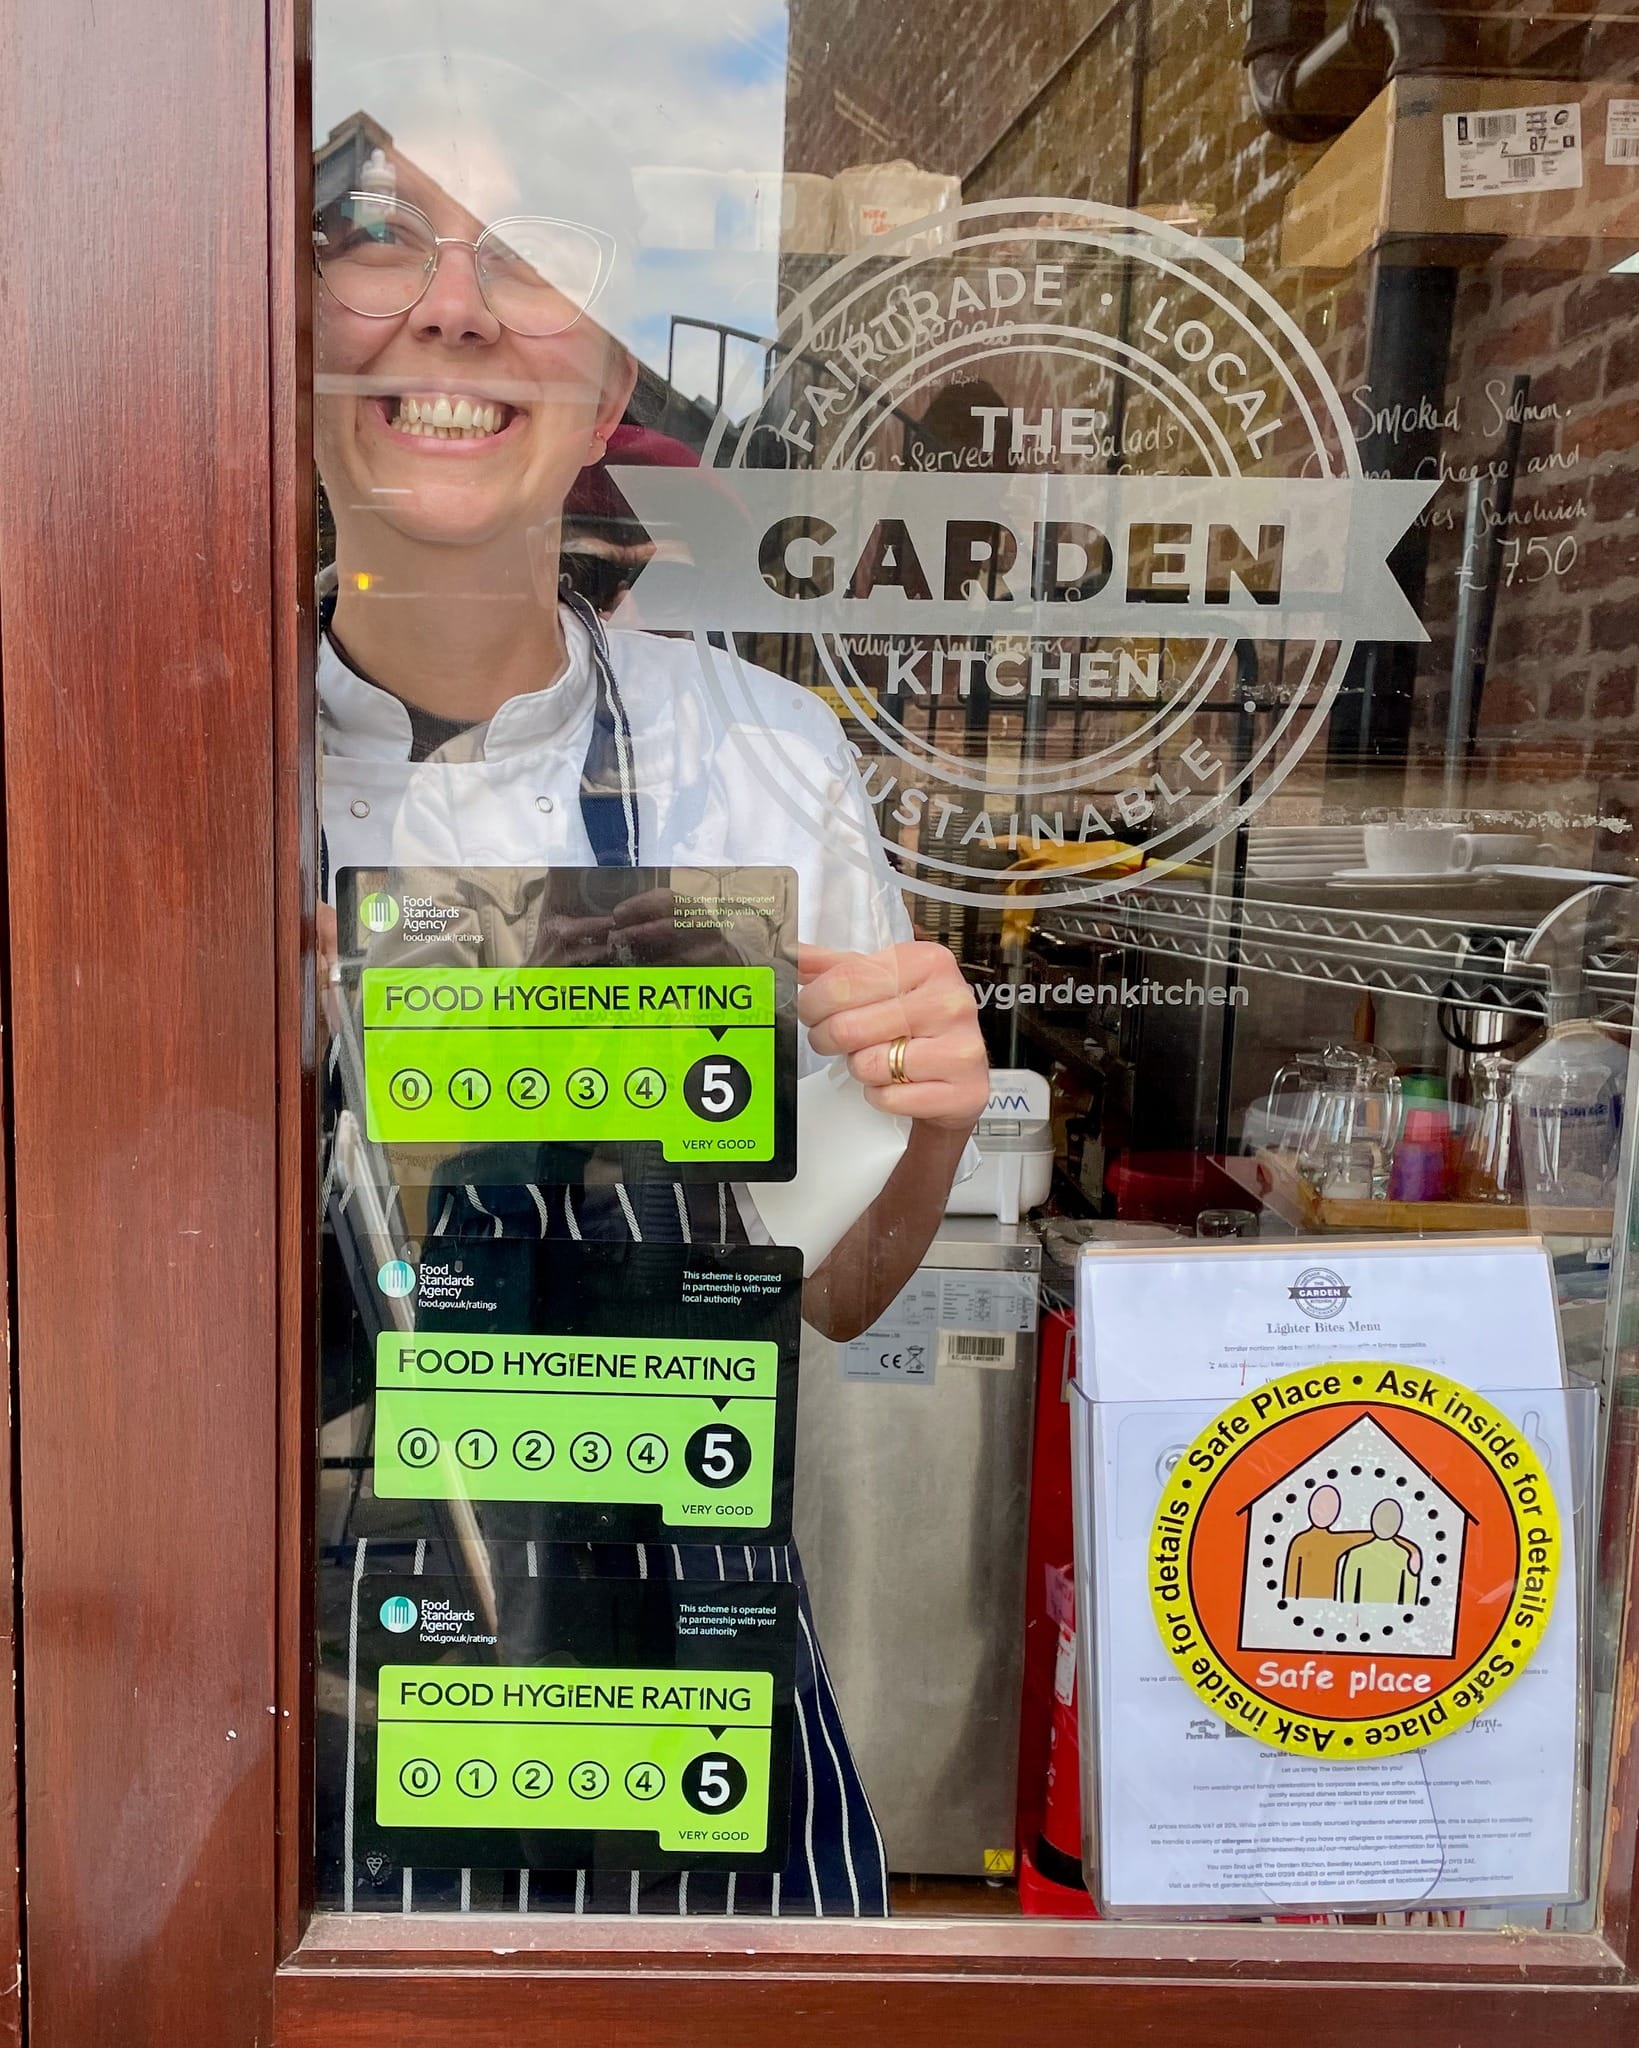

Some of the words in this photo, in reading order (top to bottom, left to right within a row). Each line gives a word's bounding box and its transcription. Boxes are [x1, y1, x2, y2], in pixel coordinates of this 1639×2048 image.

[779, 264, 1065, 452] FAIRTRADE
[1142, 296, 1284, 461] LOCAL
[1352, 384, 1461, 444] Smoked
[971, 407, 1096, 454] THE
[910, 442, 994, 472] Served
[1414, 452, 1509, 485] Cheese
[1527, 443, 1580, 474] and
[1473, 497, 1587, 538] Sandwich
[758, 516, 1286, 605] GARDEN
[887, 651, 1159, 697] KITCHEN
[826, 737, 1222, 850] SUSTAINABLE
[402, 895, 433, 907] Food
[403, 907, 459, 918] Standards
[673, 908, 682, 916] in
[684, 908, 733, 917] partnership
[735, 907, 754, 916] with
[756, 909, 775, 917] your
[674, 896, 691, 904] This
[693, 896, 725, 904] scheme
[728, 896, 735, 904] is
[736, 896, 775, 905] operated
[403, 919, 447, 932] Agency
[403, 933, 484, 943] food.gov.uk/ratings
[674, 920, 694, 928] local
[696, 920, 735, 929] authority
[386, 986, 483, 1011] FOOD
[639, 984, 752, 1010] RATING
[968, 978, 1250, 1010] ygardenkitchen
[700, 1065, 735, 1113] 5
[682, 1139, 714, 1150] VERY
[717, 1139, 756, 1150] GOOD
[420, 1264, 448, 1275] Food
[420, 1275, 474, 1286] Standards
[683, 1271, 699, 1279] This
[701, 1272, 733, 1280] scheme
[743, 1274, 782, 1283] operated
[419, 1285, 462, 1299] Agency
[682, 1282, 690, 1291] in
[692, 1284, 740, 1294] partnership
[741, 1284, 760, 1293] with
[762, 1287, 782, 1295] your
[682, 1294, 702, 1302] local
[703, 1295, 742, 1306] authority
[1299, 1289, 1340, 1297] GARDEN
[418, 1299, 497, 1311] food.gov.uk/ratings
[1267, 1322, 1311, 1337] Lighter
[1315, 1321, 1345, 1333] Bites
[1349, 1321, 1381, 1332] Menu
[399, 1349, 493, 1374] FOOD
[645, 1356, 755, 1381] RATING
[1375, 1369, 1440, 1407] Ask
[1188, 1415, 1251, 1474] Safe
[1251, 1374, 1342, 1420] Place
[1443, 1392, 1520, 1471] inside
[701, 1433, 735, 1480] 5
[1512, 1472, 1543, 1516] for
[682, 1504, 712, 1515] VERY
[715, 1505, 754, 1516] GOOD
[1154, 1498, 1190, 1602] details
[1514, 1527, 1553, 1629] details
[421, 1599, 450, 1610] Food
[421, 1610, 475, 1621] Standards
[680, 1604, 696, 1612] This
[698, 1605, 729, 1613] scheme
[731, 1605, 737, 1613] is
[739, 1607, 776, 1615] operated
[420, 1620, 462, 1633] Agency
[679, 1616, 687, 1624] in
[689, 1616, 736, 1626] partnership
[737, 1617, 756, 1625] with
[757, 1619, 777, 1627] your
[679, 1627, 698, 1635] local
[699, 1627, 737, 1637] authority
[1166, 1612, 1198, 1657] for
[420, 1634, 497, 1645] food.gov.uk/ratings
[1191, 1656, 1270, 1725] inside
[1255, 1660, 1335, 1691] Safe
[1349, 1663, 1432, 1698] place
[1452, 1652, 1515, 1708] Safe
[400, 1682, 494, 1707] FOOD
[642, 1687, 751, 1712] RATING
[1273, 1713, 1336, 1752] Ask
[1364, 1703, 1448, 1746] place
[697, 1761, 731, 1806] 5
[678, 1829, 708, 1840] VERY
[711, 1830, 749, 1841] GOOD
